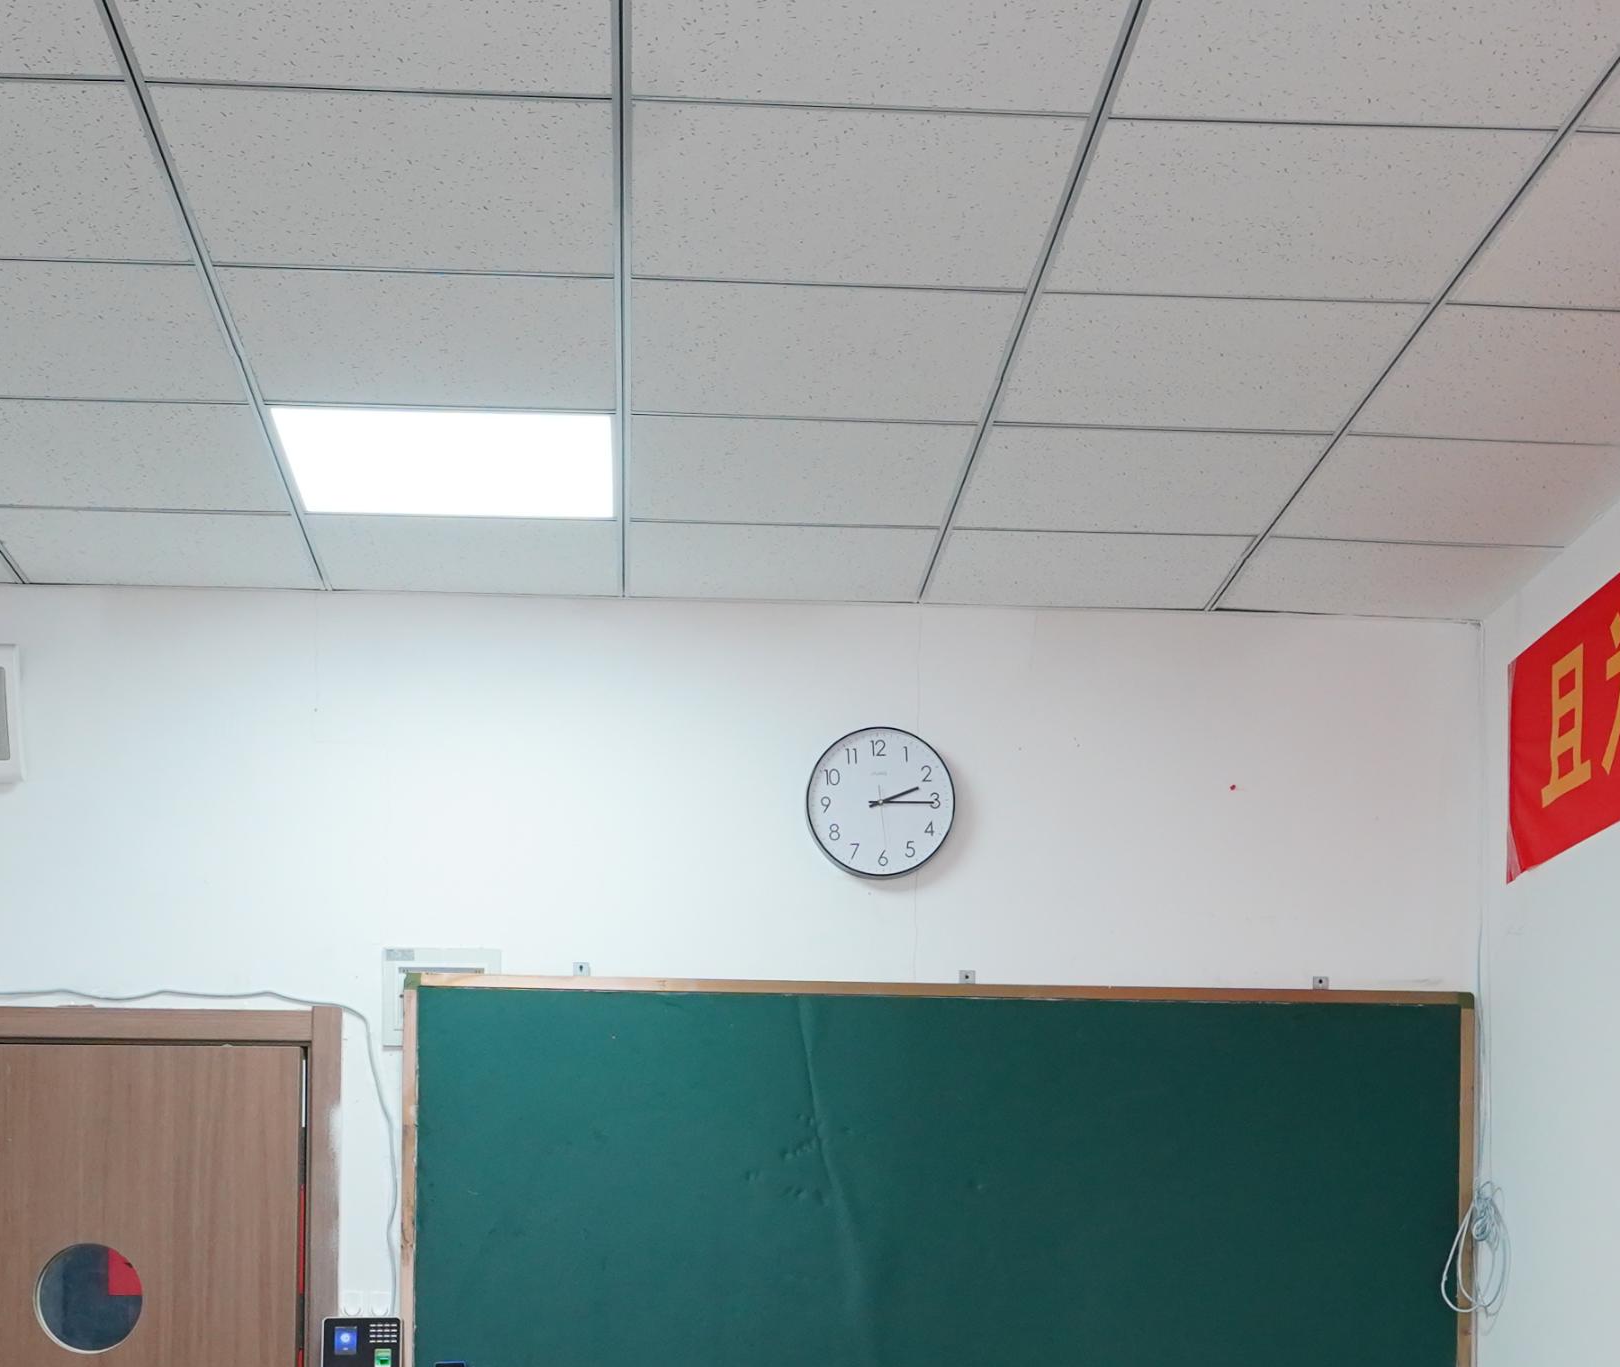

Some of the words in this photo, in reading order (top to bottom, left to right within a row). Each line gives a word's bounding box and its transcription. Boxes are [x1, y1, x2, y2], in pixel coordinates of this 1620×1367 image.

[844, 747, 858, 765] 11
[870, 739, 887, 757] 12
[903, 745, 909, 763] 1
[823, 768, 841, 786] 10
[920, 764, 932, 783] 2
[820, 796, 831, 813] 9
[929, 792, 941, 809] 3
[828, 823, 841, 841] 8
[924, 820, 935, 836] 4
[850, 843, 860, 859] 7
[905, 840, 916, 858] 5
[877, 850, 889, 867] 6
